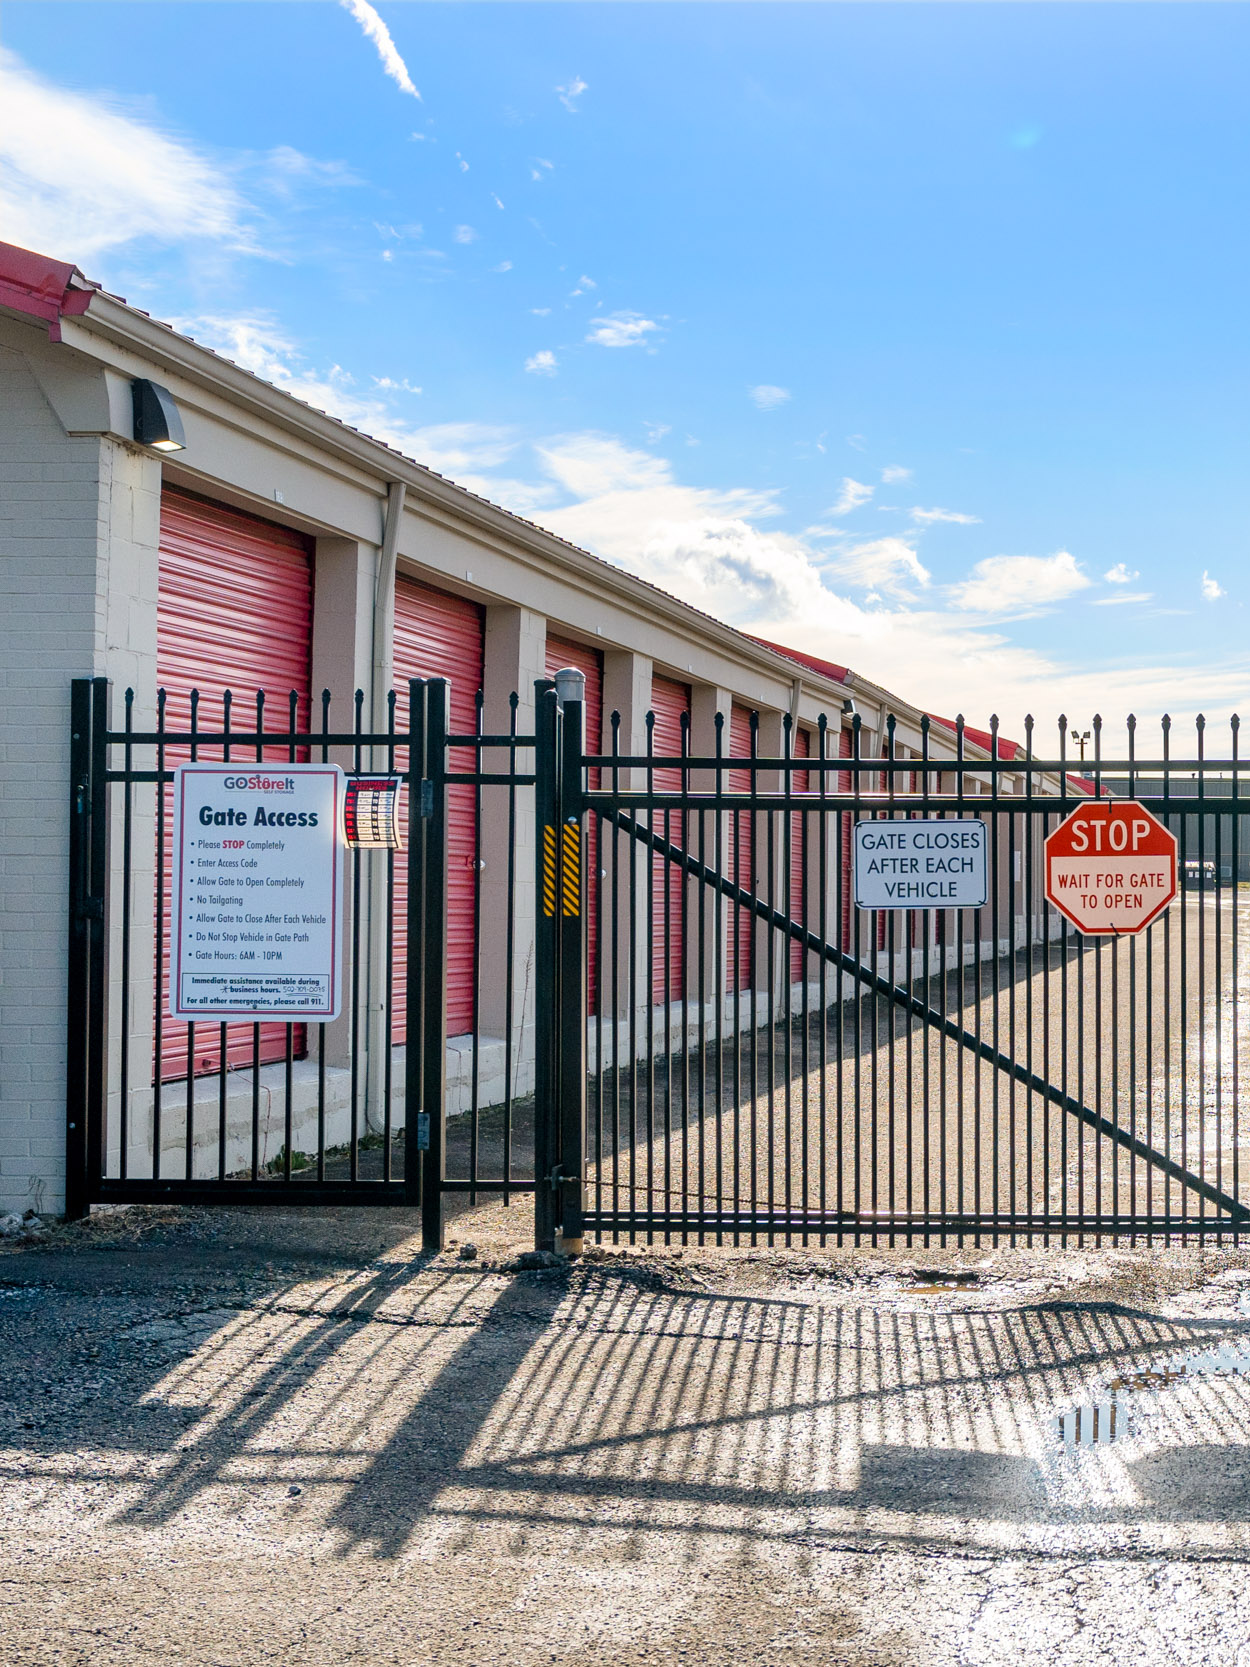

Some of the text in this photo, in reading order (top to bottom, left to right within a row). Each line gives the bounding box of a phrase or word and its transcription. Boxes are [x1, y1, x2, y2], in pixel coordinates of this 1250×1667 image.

[199, 806, 319, 827] Gate Access
[861, 832, 980, 850] GATE CLOSES
[1070, 819, 1151, 852] STOP
[198, 840, 285, 851] Please STOP Completely
[197, 858, 258, 868] Enter Access Code
[867, 856, 974, 874] AFTER EACH
[197, 877, 305, 888] Allow Gate to Open Completely
[1057, 873, 1165, 888] WAIT FOR GATE
[884, 881, 957, 898] VEHICLE
[197, 895, 244, 906] No Tailgating
[1080, 894, 1143, 908] TO OPEN
[196, 913, 327, 924] Allow Gate to Close After Each Vehicle
[196, 932, 310, 943] Do Not Stop Vehicle in Gate Path
[195, 950, 213, 960] Gate
[214, 951, 237, 960] Hours:
[239, 951, 256, 960] 6AM
[262, 951, 283, 961] 10PM
[265, 977, 297, 985] available
[298, 978, 320, 987] during
[230, 985, 282, 993] business hours.
[199, 996, 208, 1004] all
[209, 996, 227, 1004] other
[229, 997, 272, 1006] emergencies,
[273, 998, 296, 1006] please
[311, 998, 325, 1006] 911.
